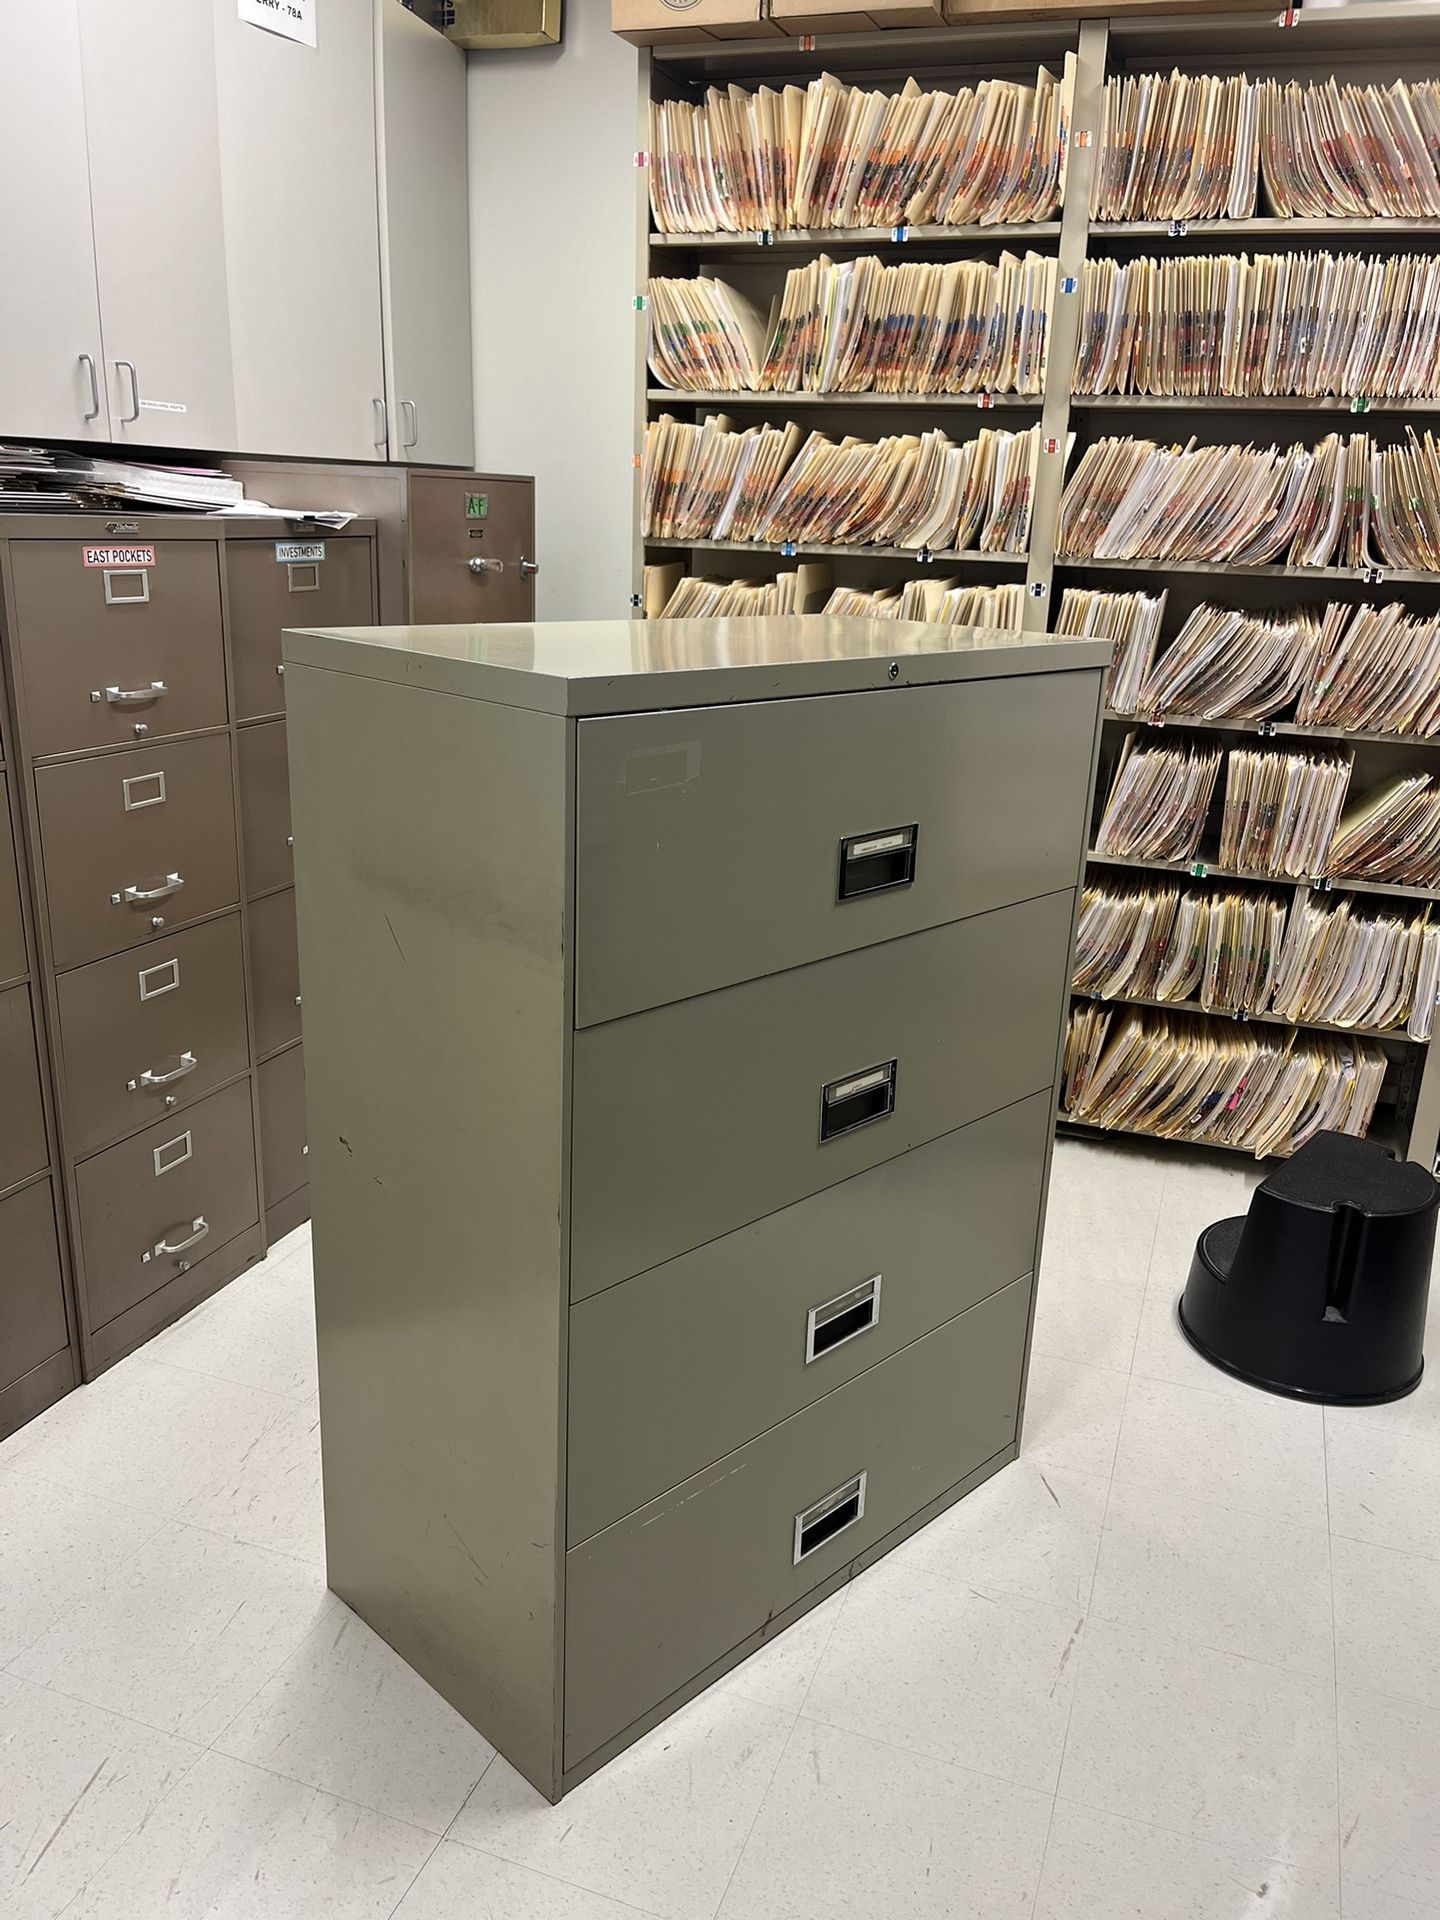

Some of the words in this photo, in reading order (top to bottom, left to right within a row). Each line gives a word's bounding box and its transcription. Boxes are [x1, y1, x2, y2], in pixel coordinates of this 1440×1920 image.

[287, 5, 303, 20] 78A
[87, 550, 110, 563] EAST
[112, 549, 153, 563] POCKETS
[279, 546, 323, 558] INVESTMENTS
